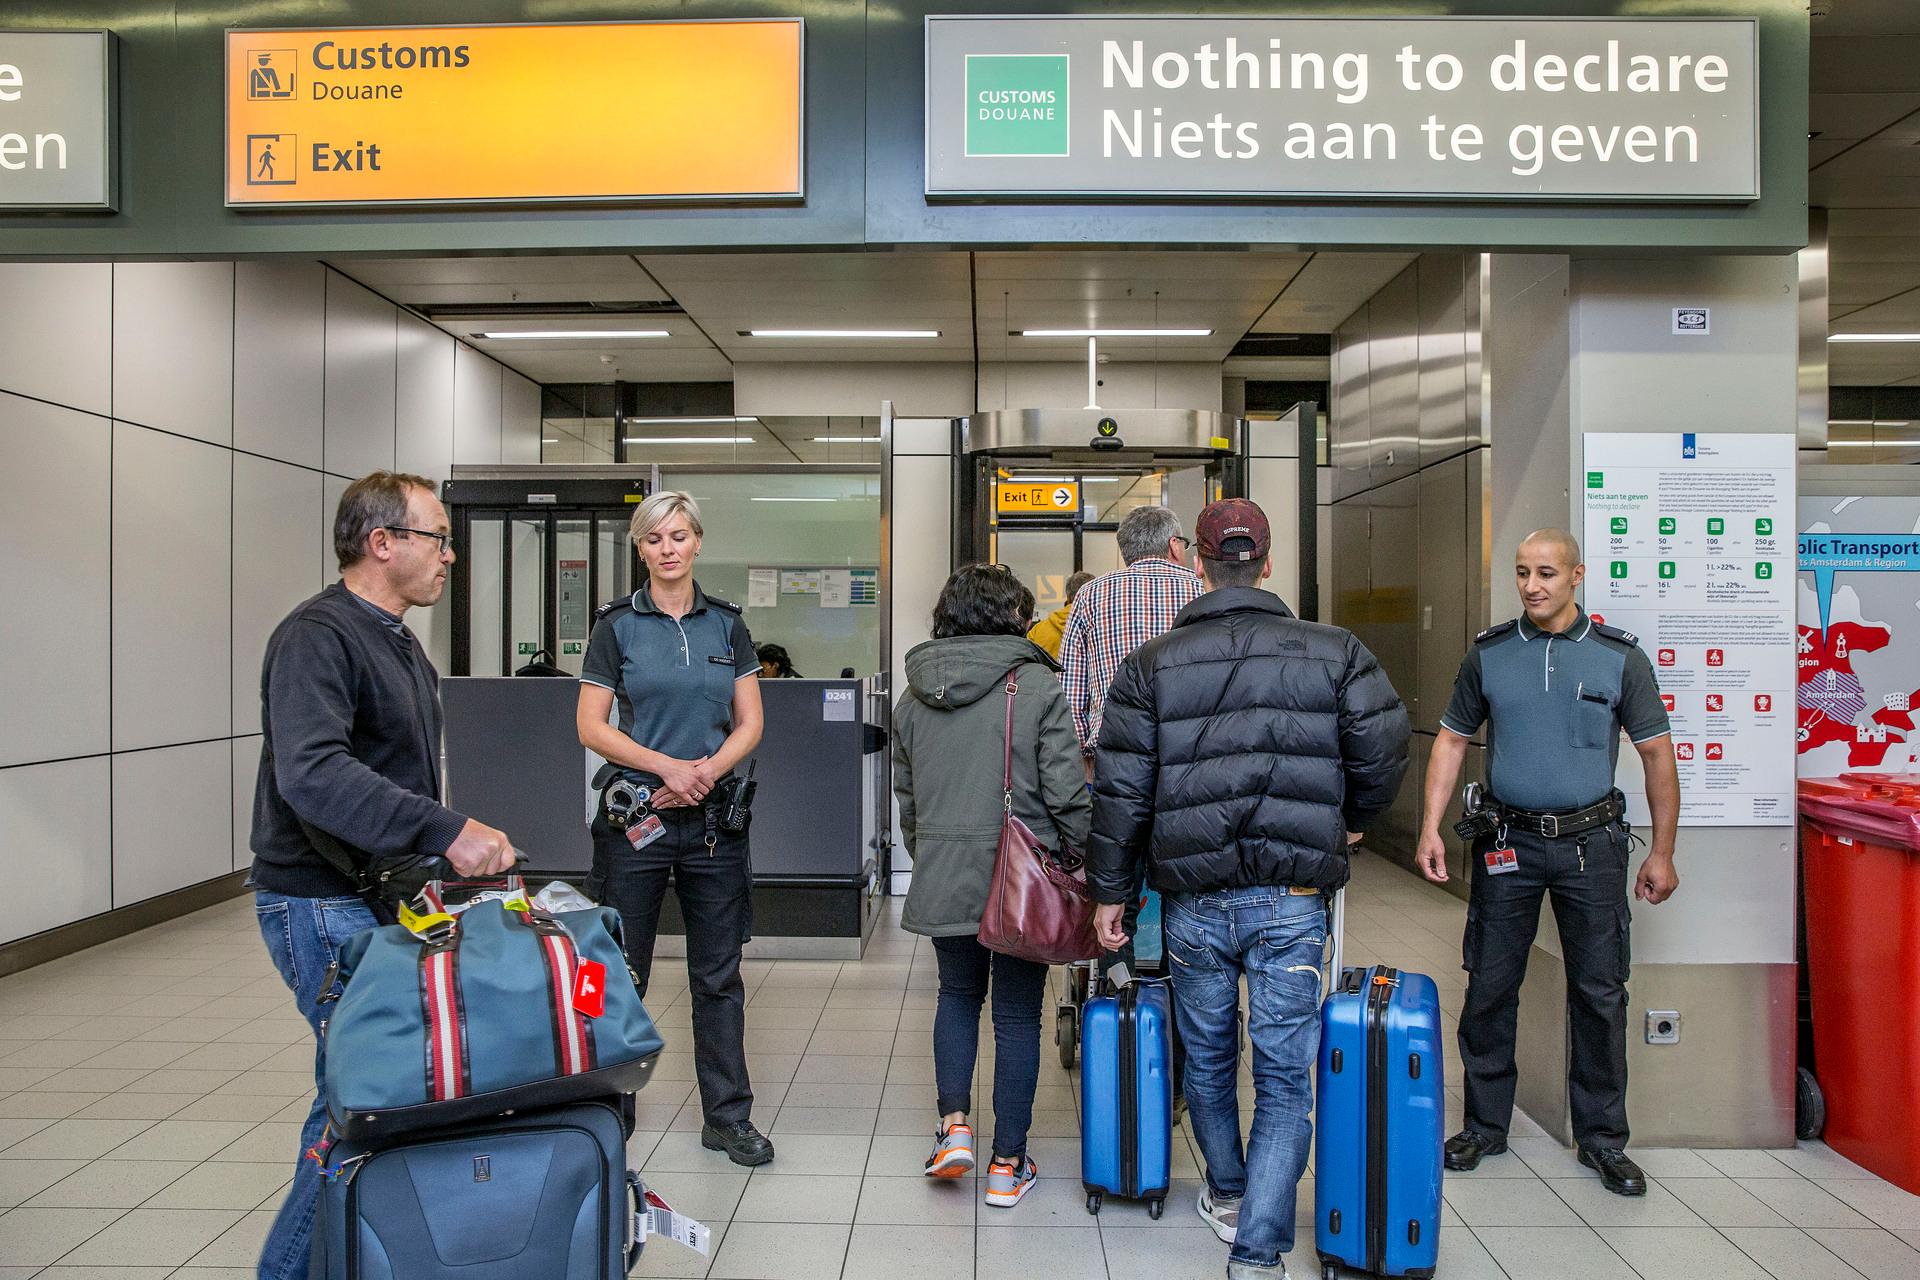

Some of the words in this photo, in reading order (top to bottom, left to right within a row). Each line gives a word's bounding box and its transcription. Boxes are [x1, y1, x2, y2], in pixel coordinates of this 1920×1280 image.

[312, 40, 470, 71] Customs
[1103, 38, 1369, 104] Nothing
[1396, 45, 1464, 92] to
[1489, 39, 1729, 93] declare
[0, 64, 23, 101] e
[312, 81, 403, 101] Douane
[979, 90, 1055, 105] CUSTOMS
[979, 108, 1055, 120] DOUANE
[1103, 107, 1260, 160] Niets
[1284, 122, 1396, 160] aan
[1421, 114, 1484, 162] te
[1509, 124, 1698, 175] geven
[0, 132, 66, 170] en
[312, 141, 381, 171] Exit
[1004, 492, 1027, 502] Exit
[1628, 494, 1649, 502] geven
[1223, 526, 1250, 535] SUPREME
[1830, 539, 1919, 559] Transport
[1799, 559, 1808, 567] ts
[1809, 557, 1863, 567] Amsterdam
[1864, 558, 1873, 567] &
[1873, 558, 1906, 568] Region
[1798, 657, 1819, 668] gion
[826, 691, 852, 701] 0241
[1806, 691, 1855, 699] Amsterdam
